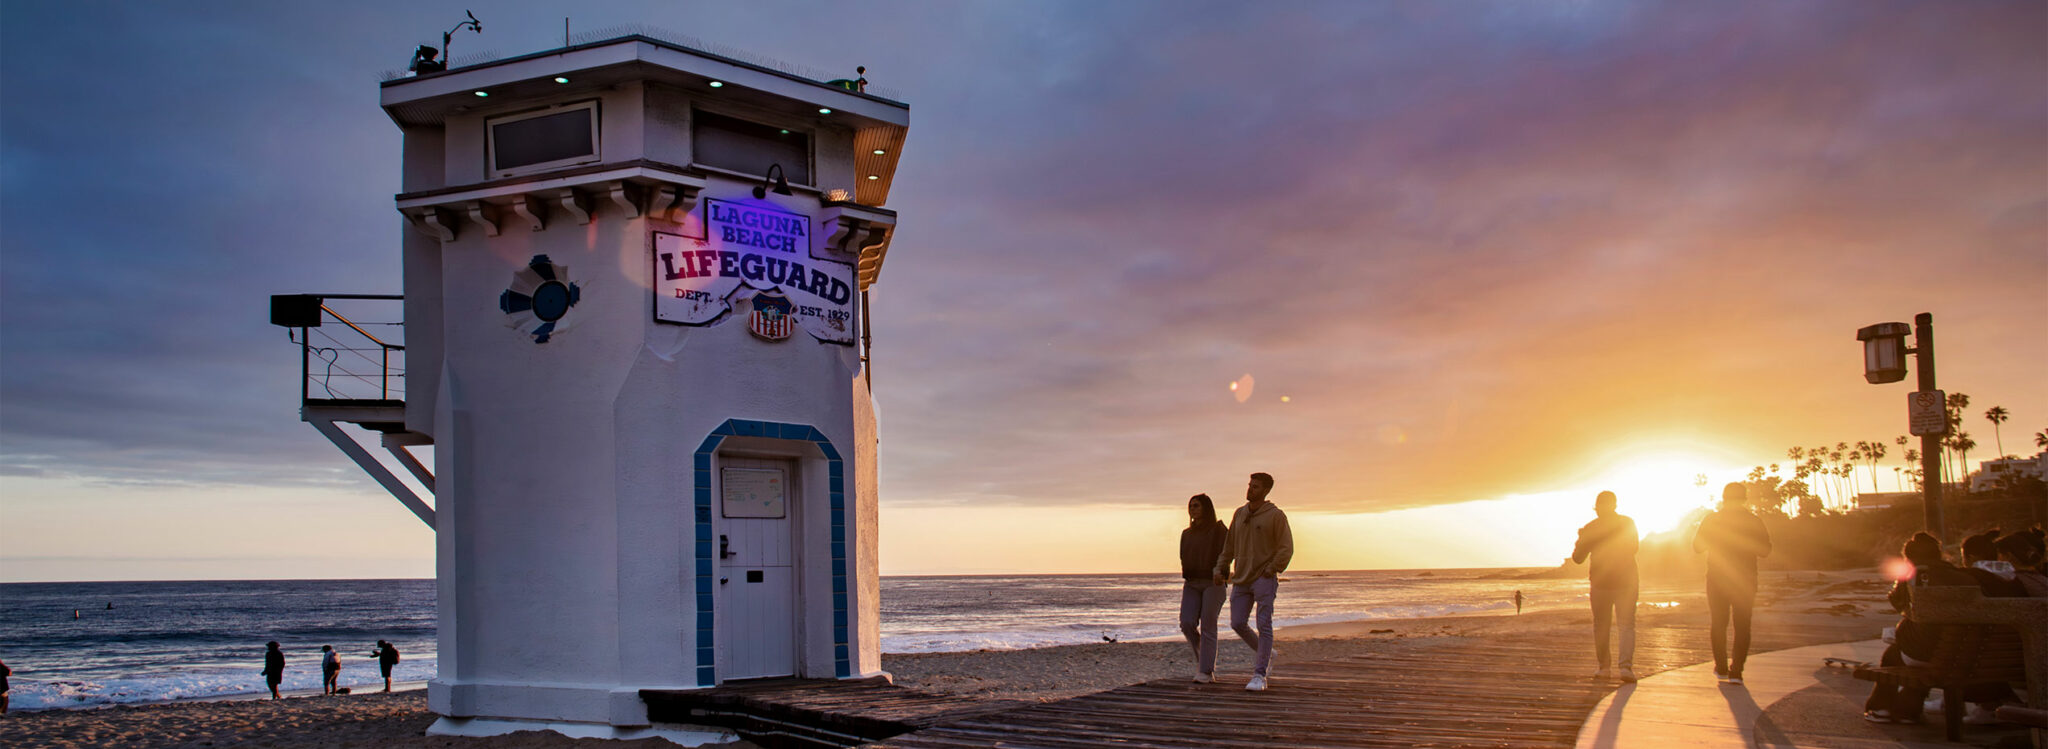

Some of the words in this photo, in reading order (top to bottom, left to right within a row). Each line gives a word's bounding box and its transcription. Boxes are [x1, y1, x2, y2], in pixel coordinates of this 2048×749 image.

[711, 204, 805, 237] LAGUNA
[722, 225, 797, 253] BEACH
[661, 250, 851, 305] LIFEGUARD
[675, 288, 713, 303] DEPT.
[799, 305, 825, 318] EST.
[827, 309, 851, 321] 1929
